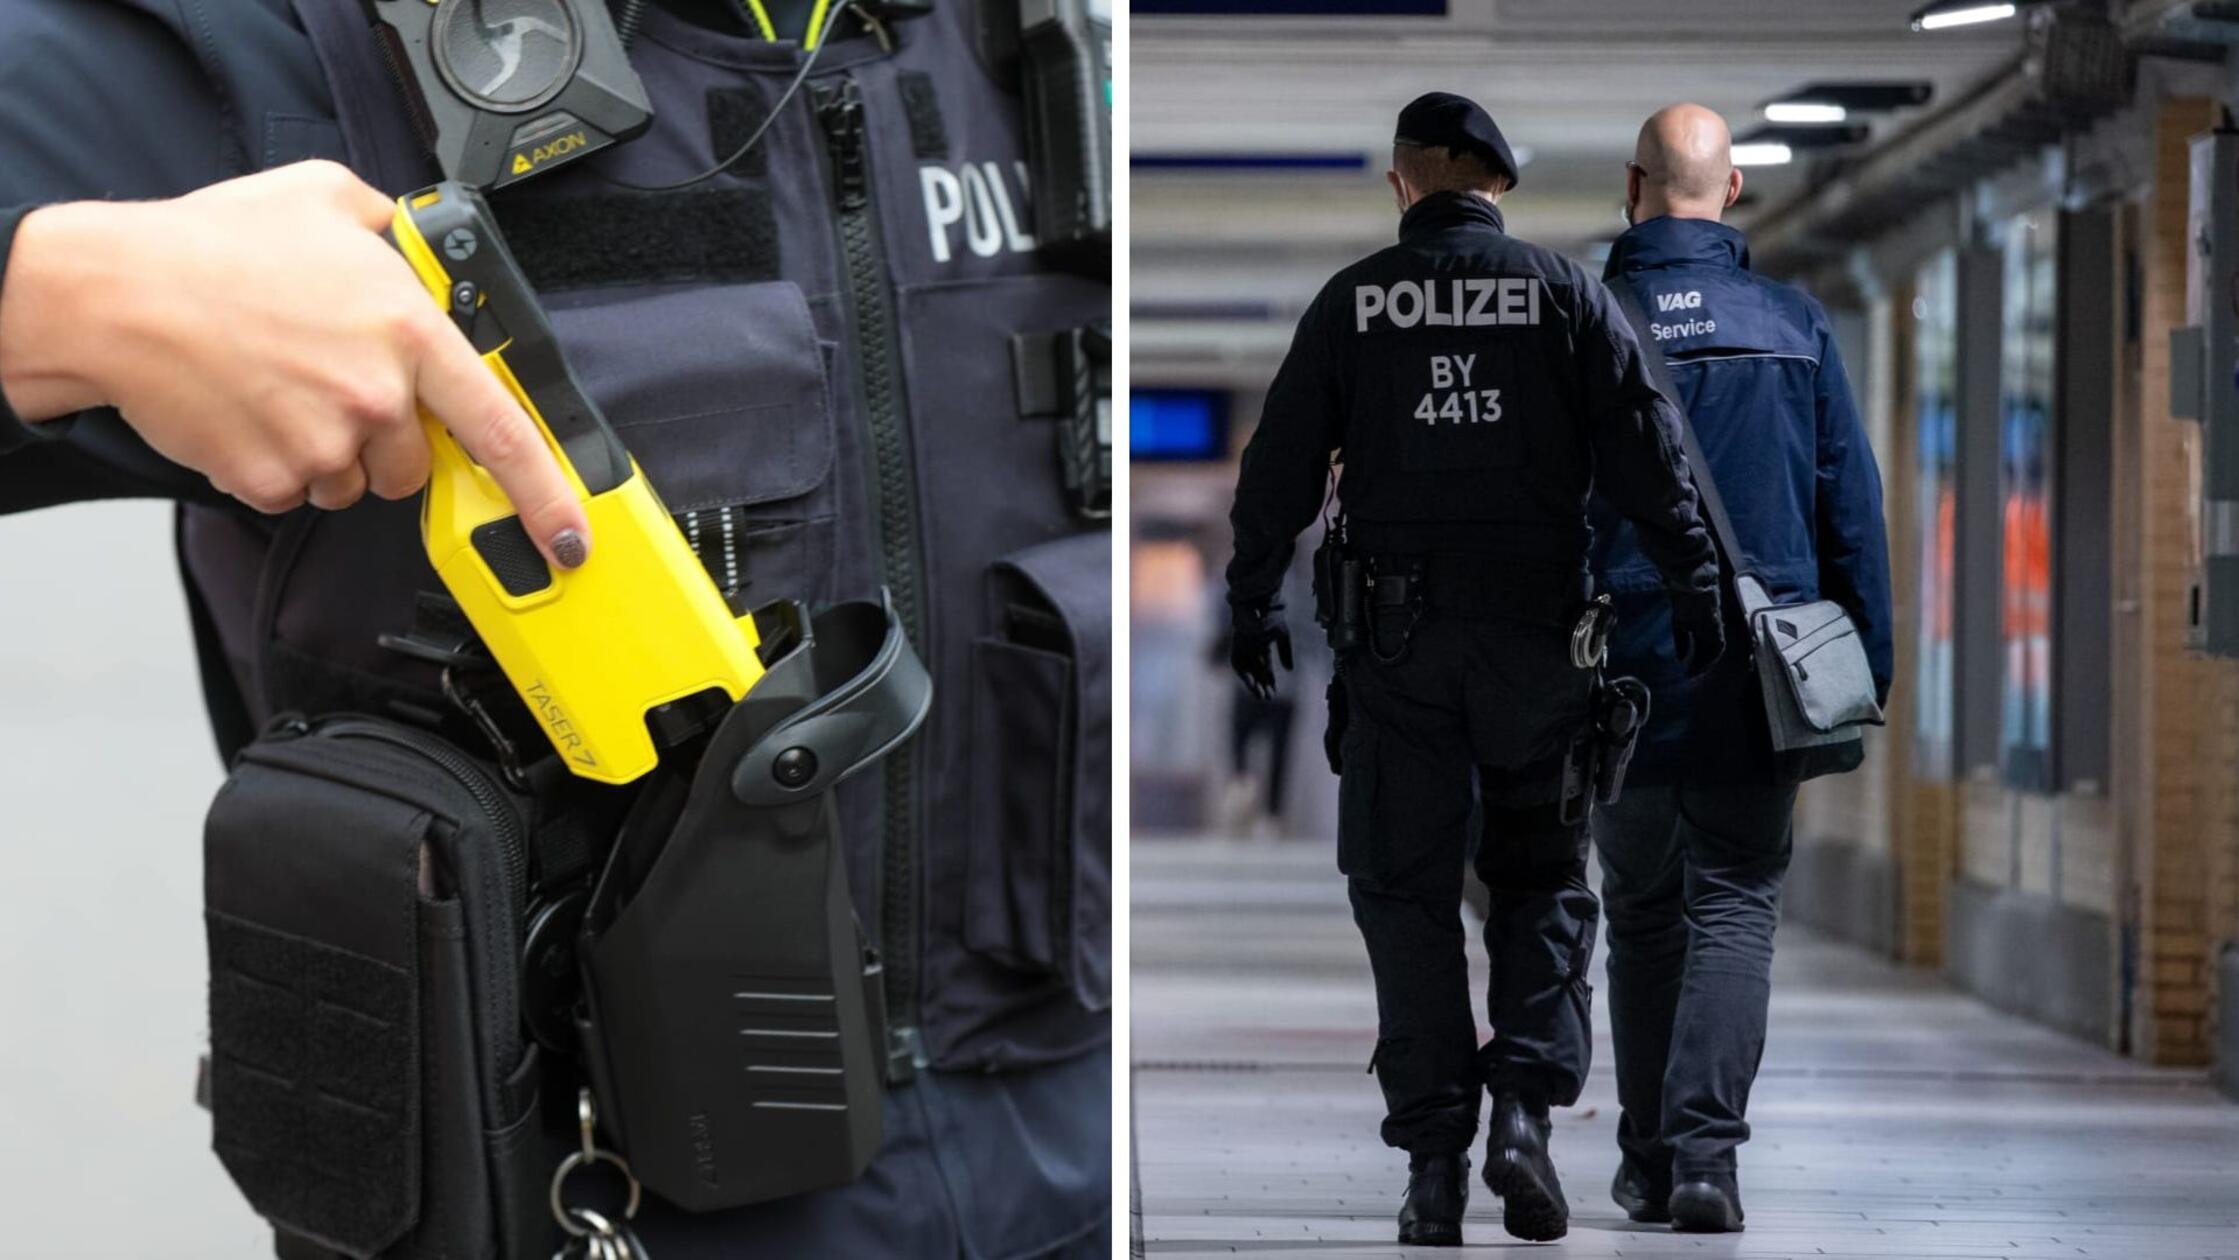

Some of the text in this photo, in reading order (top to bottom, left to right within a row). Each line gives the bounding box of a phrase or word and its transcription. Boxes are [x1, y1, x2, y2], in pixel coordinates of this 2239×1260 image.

[533, 131, 586, 164] AXON
[919, 161, 1040, 263] POL
[1355, 278, 1540, 332] POLIZEI
[1656, 291, 1701, 312] VAG
[1650, 319, 1716, 341] Service
[1430, 354, 1476, 389] BY
[1414, 389, 1502, 425] 4413
[526, 679, 598, 768] TASER 7
